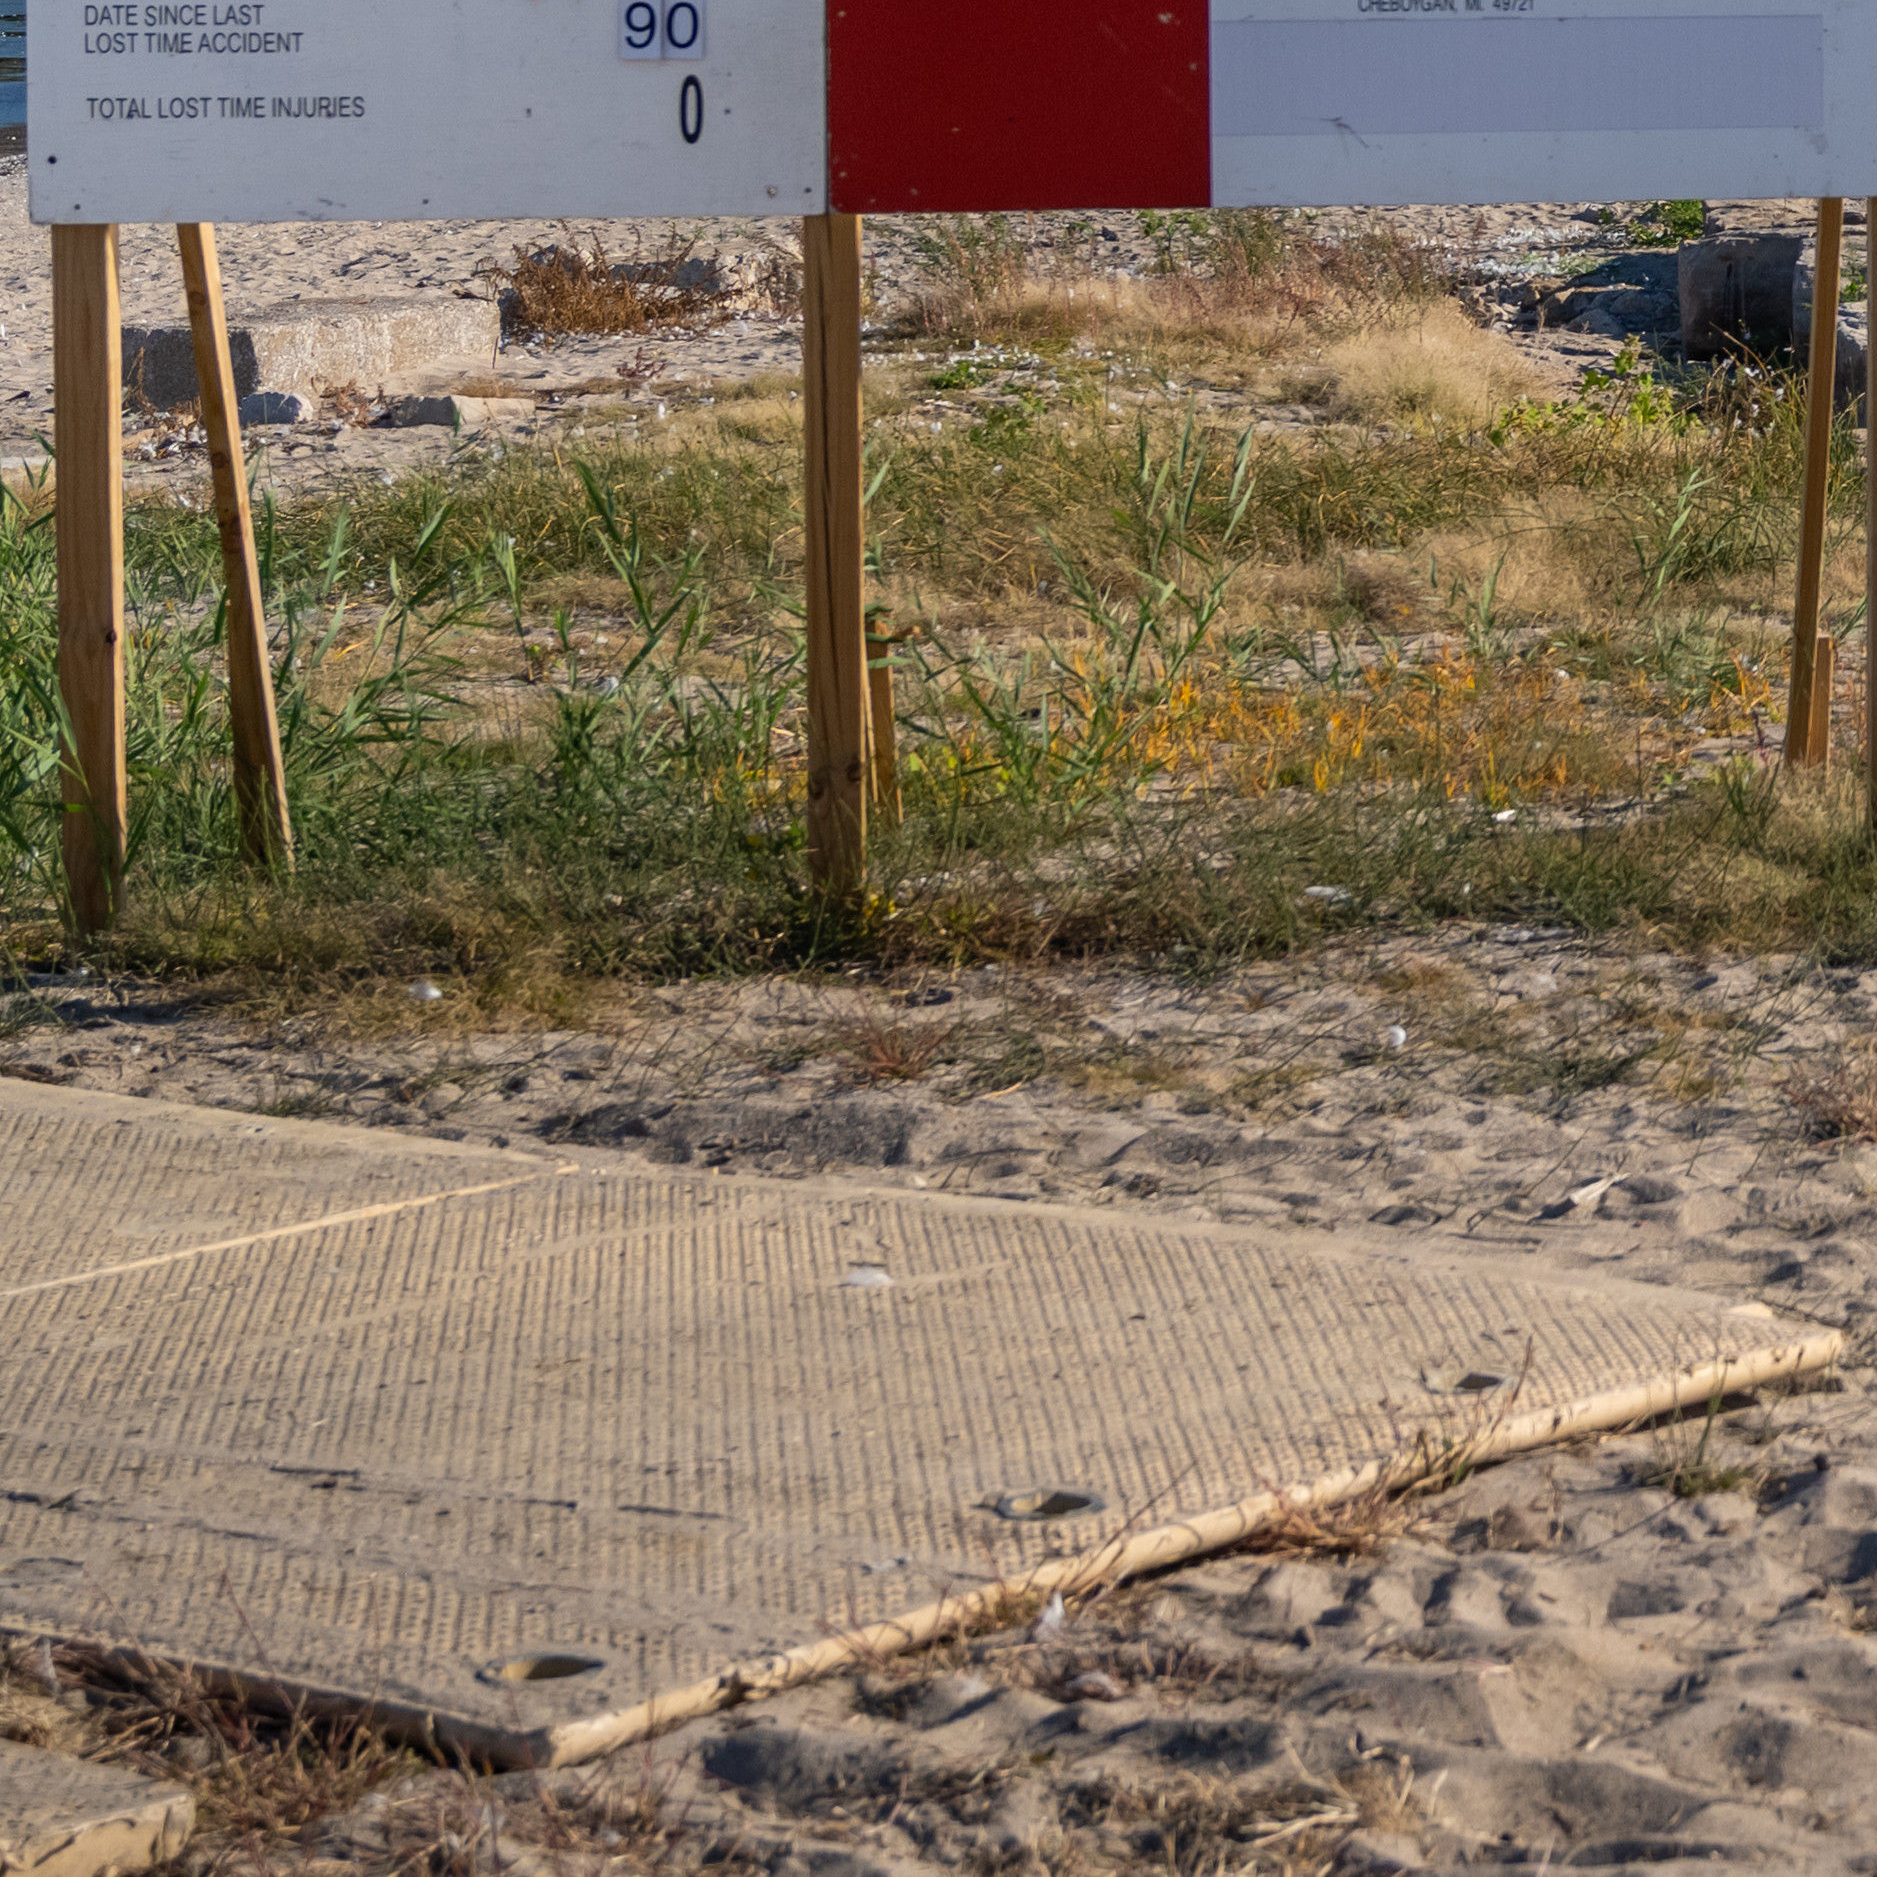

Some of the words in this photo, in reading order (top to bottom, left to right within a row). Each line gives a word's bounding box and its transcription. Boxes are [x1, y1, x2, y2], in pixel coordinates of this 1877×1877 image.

[85, 5, 138, 26] DATE
[144, 5, 206, 27] SINCE
[213, 4, 264, 26] LAST
[624, 2, 700, 49] 90
[85, 33, 138, 53] LOST
[145, 33, 192, 54] TIME
[198, 32, 303, 53] ACCIDENT
[87, 98, 152, 119] TOTAL
[157, 97, 212, 118] LOST
[217, 97, 265, 118] TIME
[272, 96, 365, 118] INJURIES
[681, 75, 703, 143] 0
